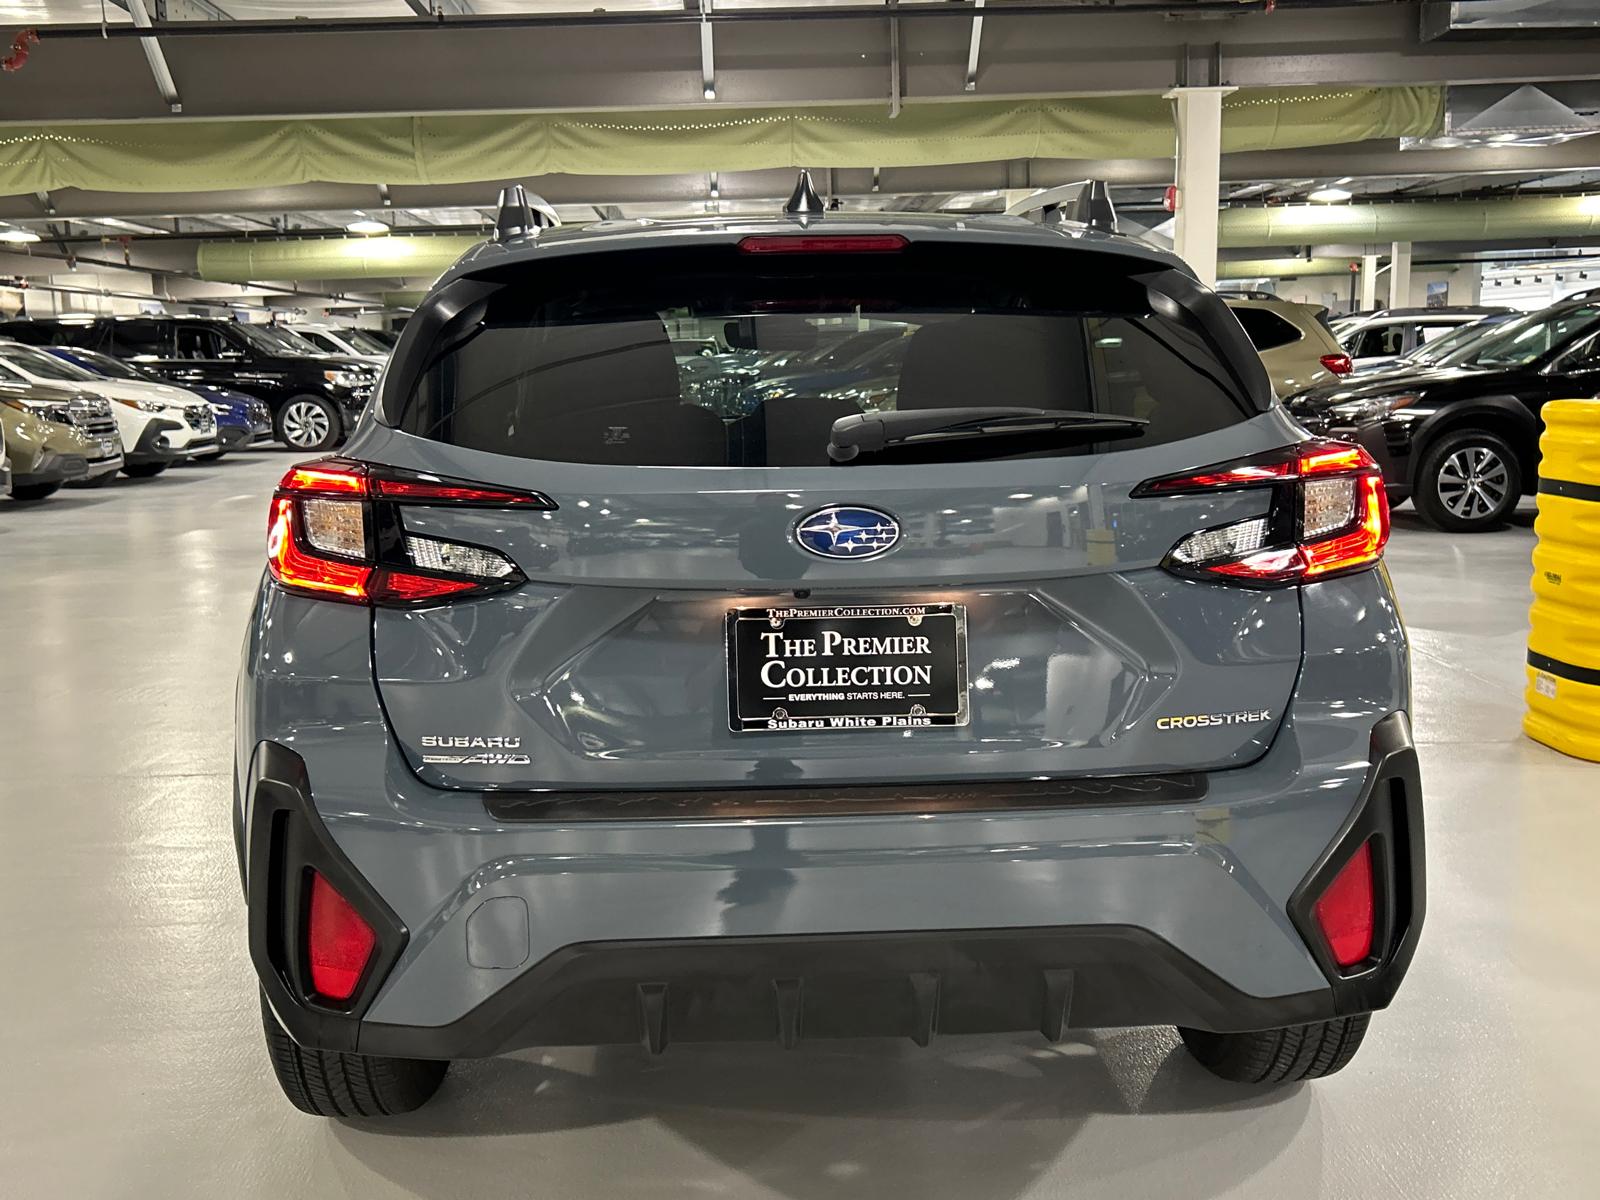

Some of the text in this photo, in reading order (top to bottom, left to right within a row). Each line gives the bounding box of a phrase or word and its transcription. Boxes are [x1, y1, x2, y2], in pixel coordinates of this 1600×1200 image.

[788, 691, 905, 701] EVERYTHING STARTS HERE.
[767, 716, 932, 730] Subaru White Plains
[1156, 708, 1272, 730] CROSSTREK
[421, 735, 521, 748] SUBARU
[461, 753, 531, 765] AWD
